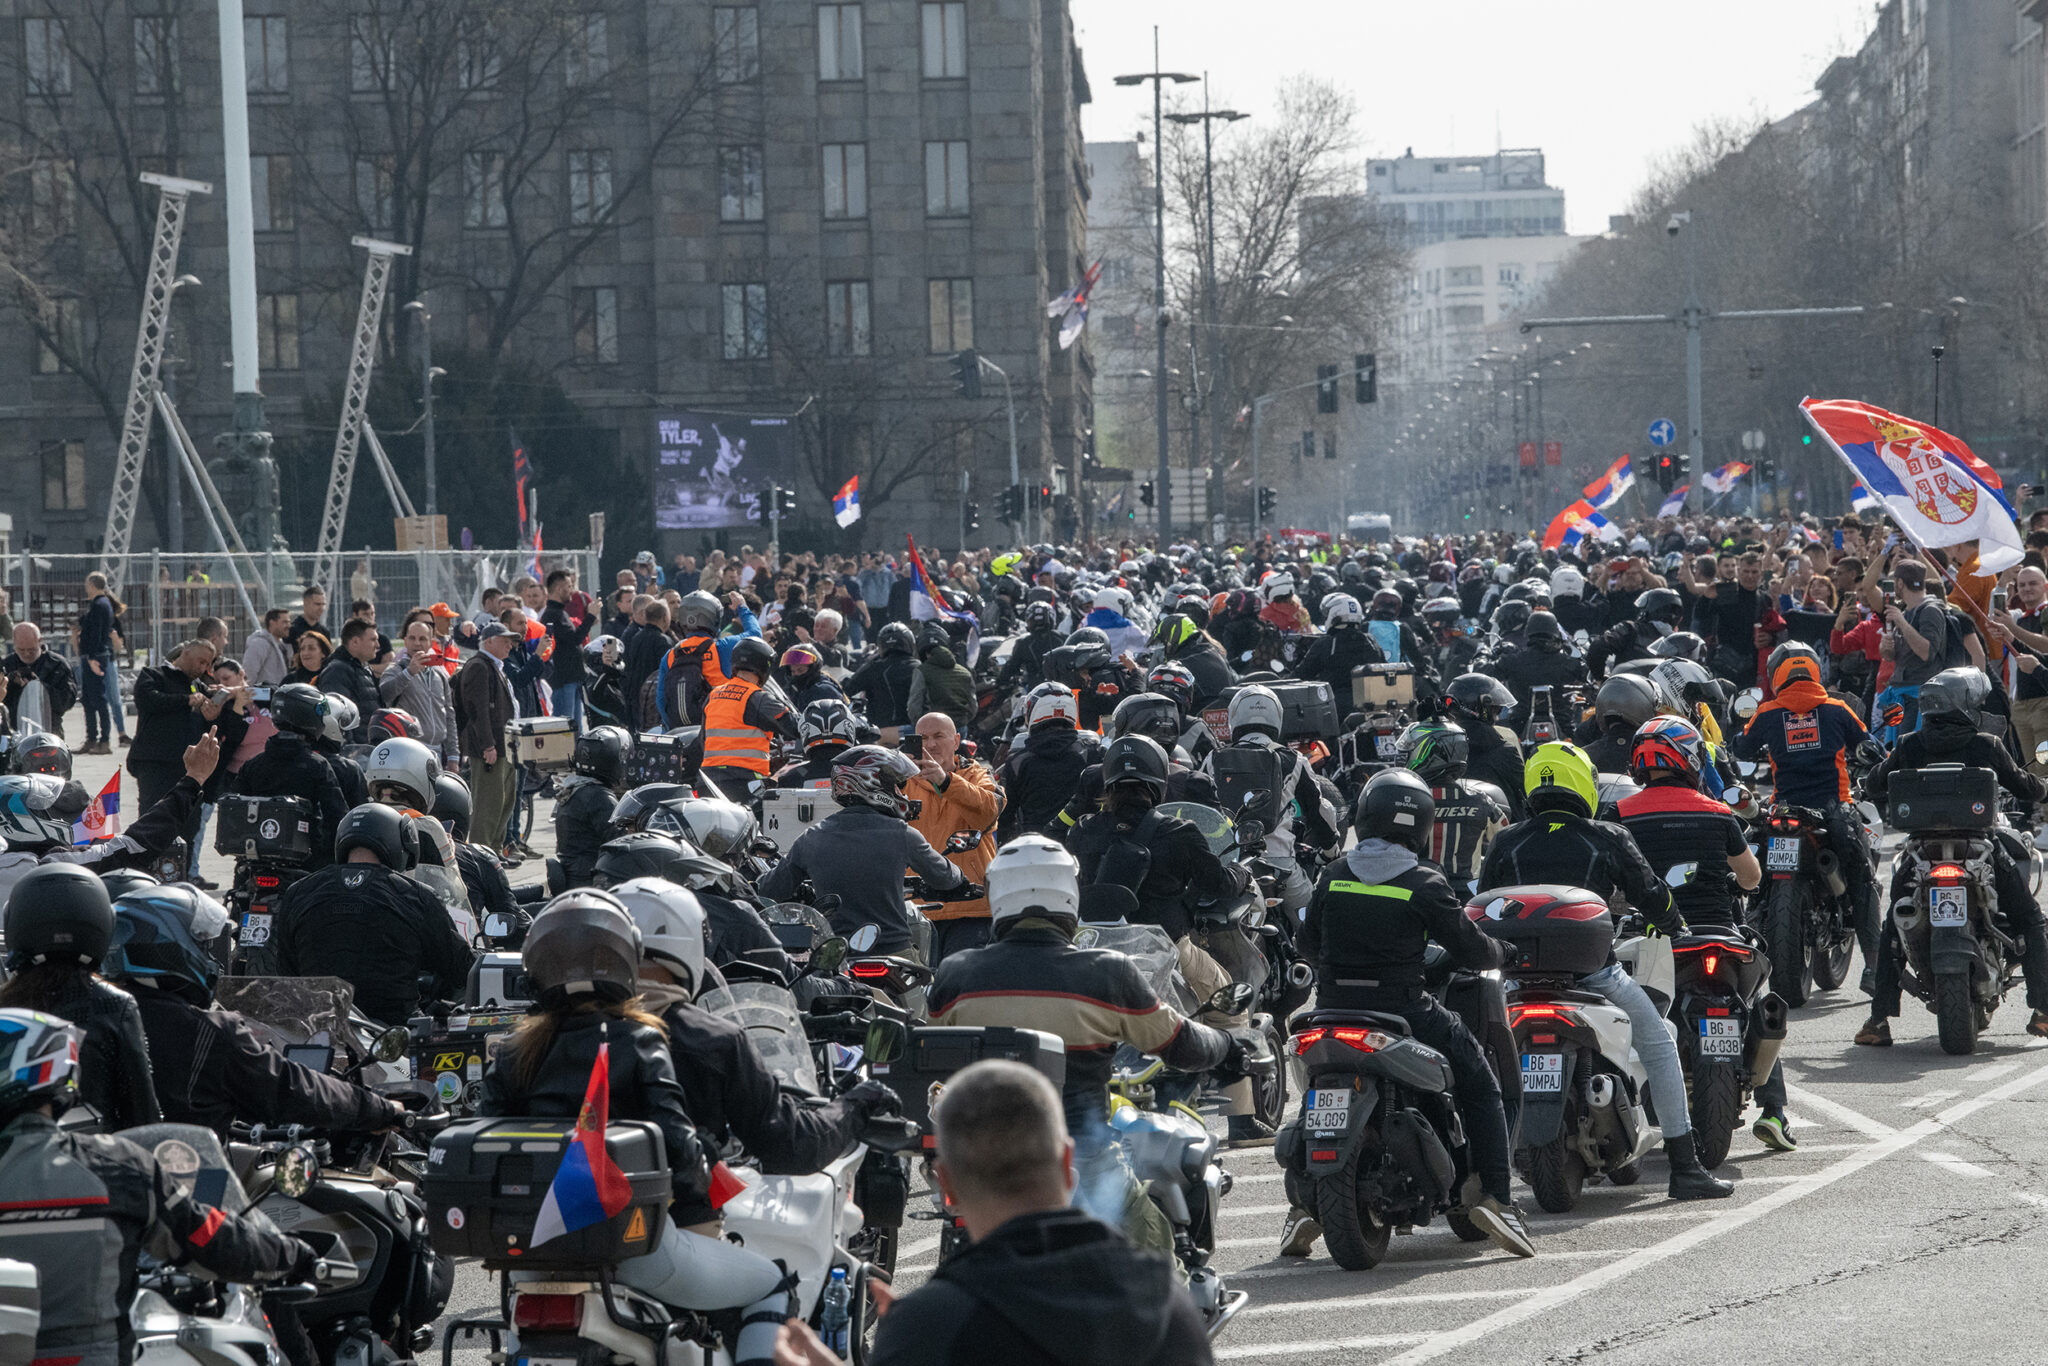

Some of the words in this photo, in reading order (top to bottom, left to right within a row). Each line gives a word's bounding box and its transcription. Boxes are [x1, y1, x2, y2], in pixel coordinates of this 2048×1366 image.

[660, 429, 703, 446] TYLER,
[1792, 732, 1813, 741] KTM
[876, 794, 893, 806] SHOEI
[1395, 801, 1419, 809] SHARK
[1775, 838, 1786, 849] BG
[1769, 852, 1798, 864] PUMPAJ
[249, 916, 260, 926] BG
[1710, 1021, 1724, 1035] BG
[1530, 1055, 1545, 1071] BG
[1523, 1074, 1561, 1090] PUMPAJ
[1318, 1092, 1333, 1107] BG
